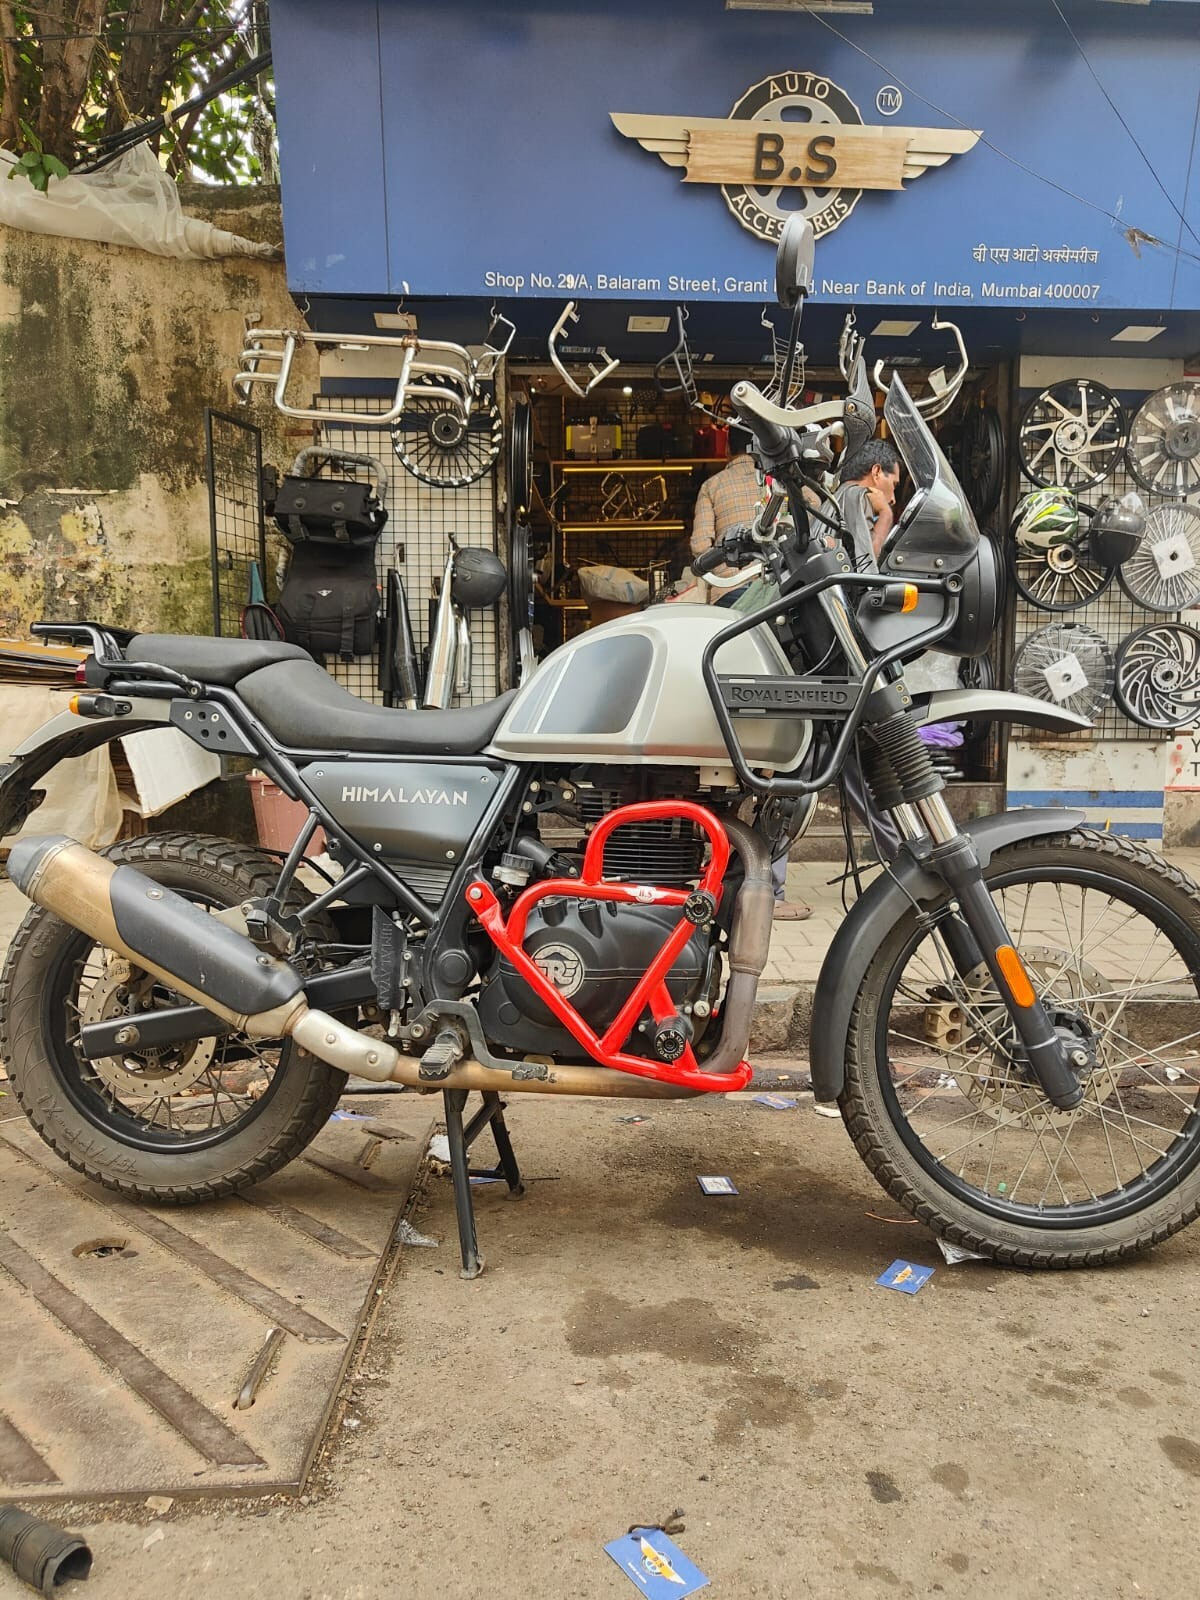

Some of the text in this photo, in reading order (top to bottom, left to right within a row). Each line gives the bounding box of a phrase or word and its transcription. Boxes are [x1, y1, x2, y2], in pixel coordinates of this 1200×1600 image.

[769, 75, 830, 99] AUTO
[879, 91, 901, 107] TM
[754, 132, 837, 183] B.S
[731, 193, 848, 239] ACCESREIS
[972, 244, 988, 263] बी
[990, 247, 1011, 265] एस
[485, 271, 525, 293] Shop
[530, 272, 555, 289] No.
[557, 273, 593, 292] 29/A,
[597, 274, 661, 290] Balaram
[668, 275, 721, 294] Street,
[724, 277, 769, 293] Grant
[822, 279, 860, 295] Near
[866, 280, 906, 296] Bank
[910, 281, 927, 296] of
[934, 281, 974, 299] India,
[981, 282, 1042, 298] Mumbai
[1044, 283, 1101, 300] 400007
[731, 686, 848, 705] ROYAL ENFIELD
[341, 786, 468, 806] HIMALAYAN
